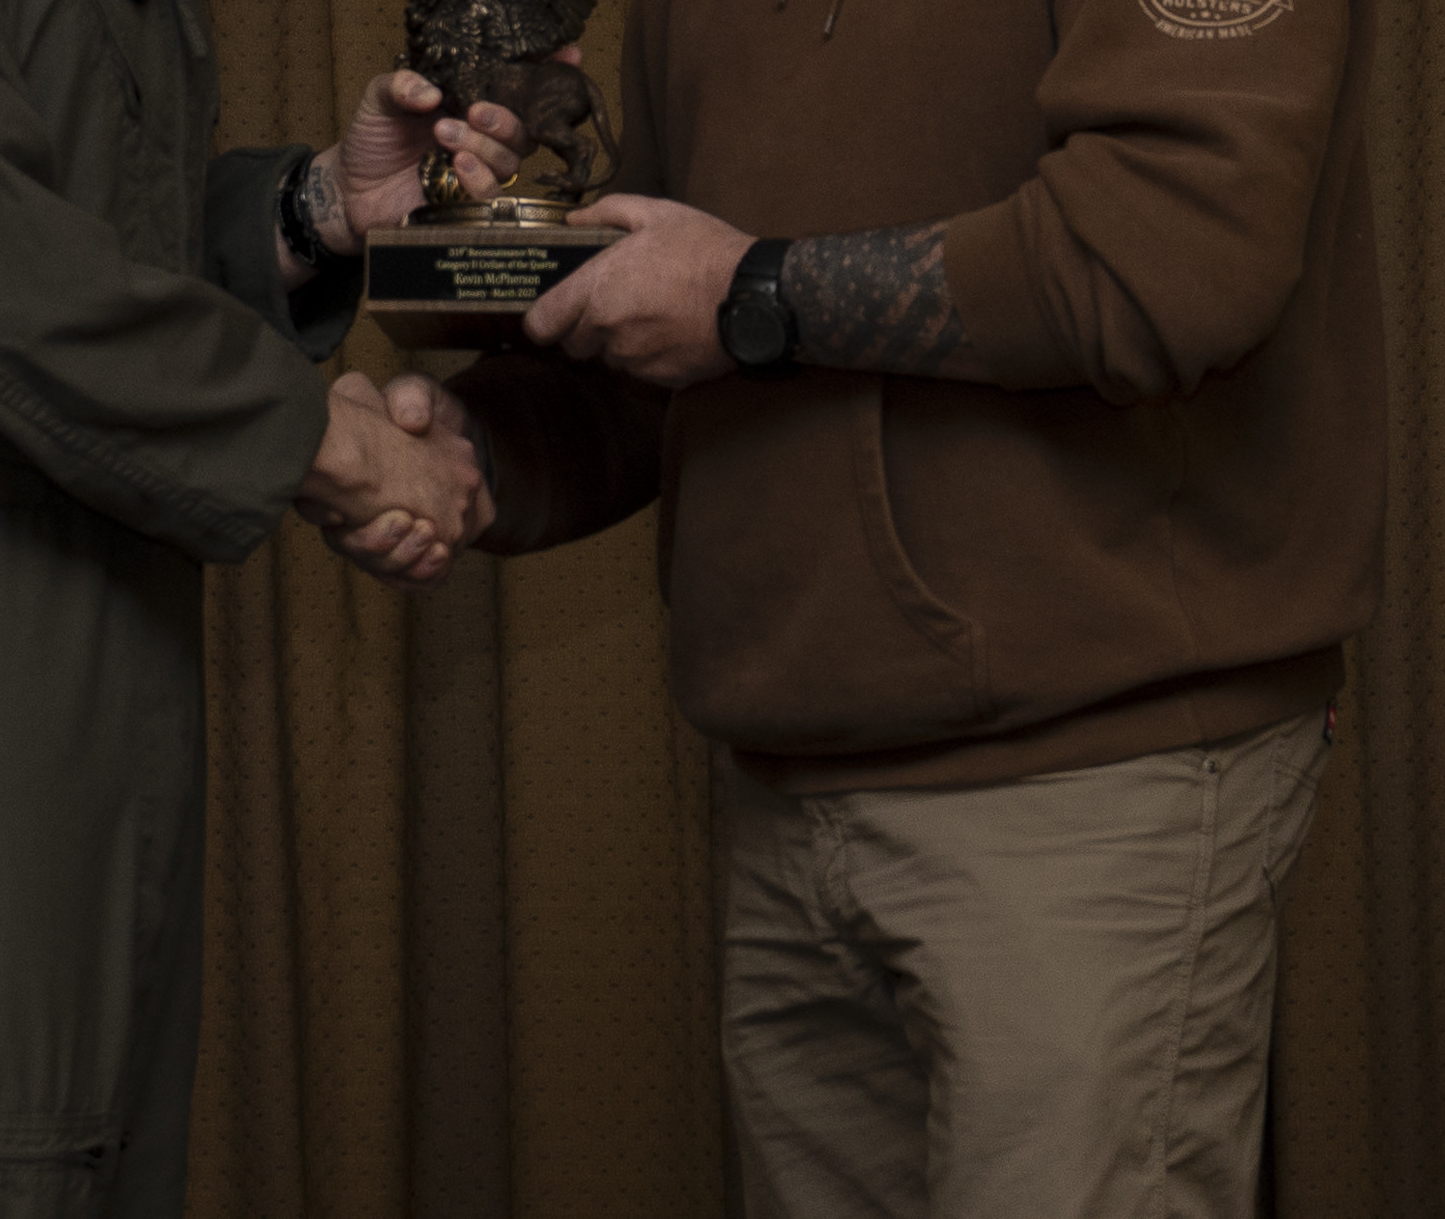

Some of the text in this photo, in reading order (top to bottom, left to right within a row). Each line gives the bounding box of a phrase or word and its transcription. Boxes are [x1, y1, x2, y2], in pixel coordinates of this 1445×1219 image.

[455, 272, 540, 285] Kevin McPherson
[458, 288, 487, 299] January
[493, 288, 516, 298] March
